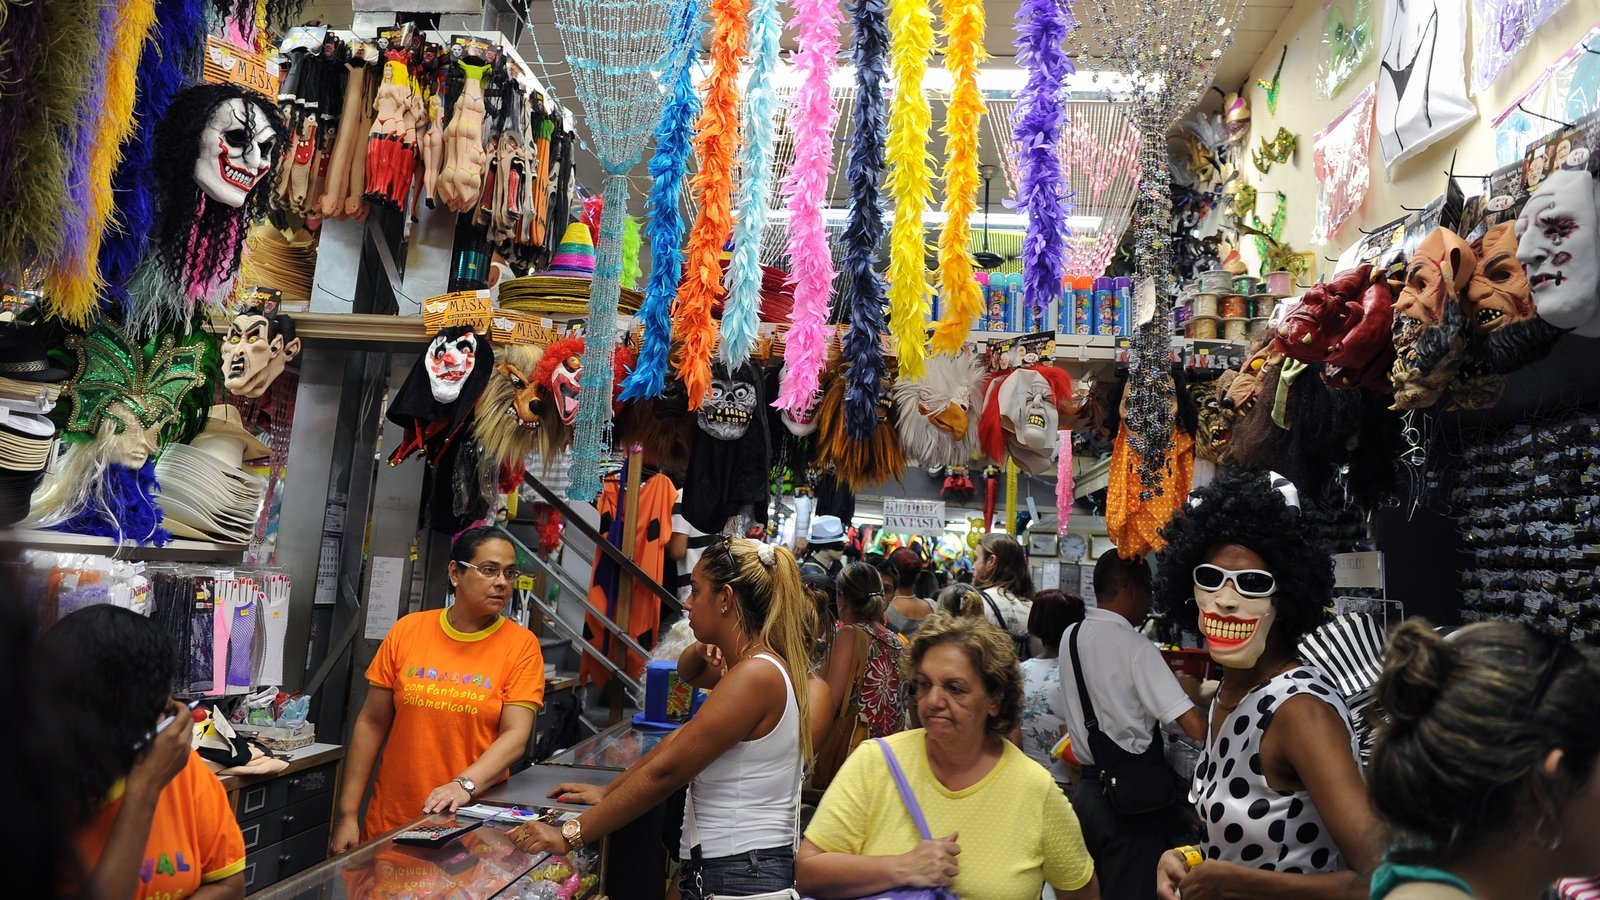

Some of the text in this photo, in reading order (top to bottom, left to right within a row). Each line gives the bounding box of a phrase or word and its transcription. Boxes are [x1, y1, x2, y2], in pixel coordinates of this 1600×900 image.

[237, 60, 274, 95] MASK
[450, 298, 487, 312] MASK
[517, 322, 548, 343] MASK
[406, 665, 493, 689] CARNAVAL
[404, 683, 485, 702] com fantasias
[403, 693, 478, 715] Sulamericana
[140, 851, 191, 885] VAL
